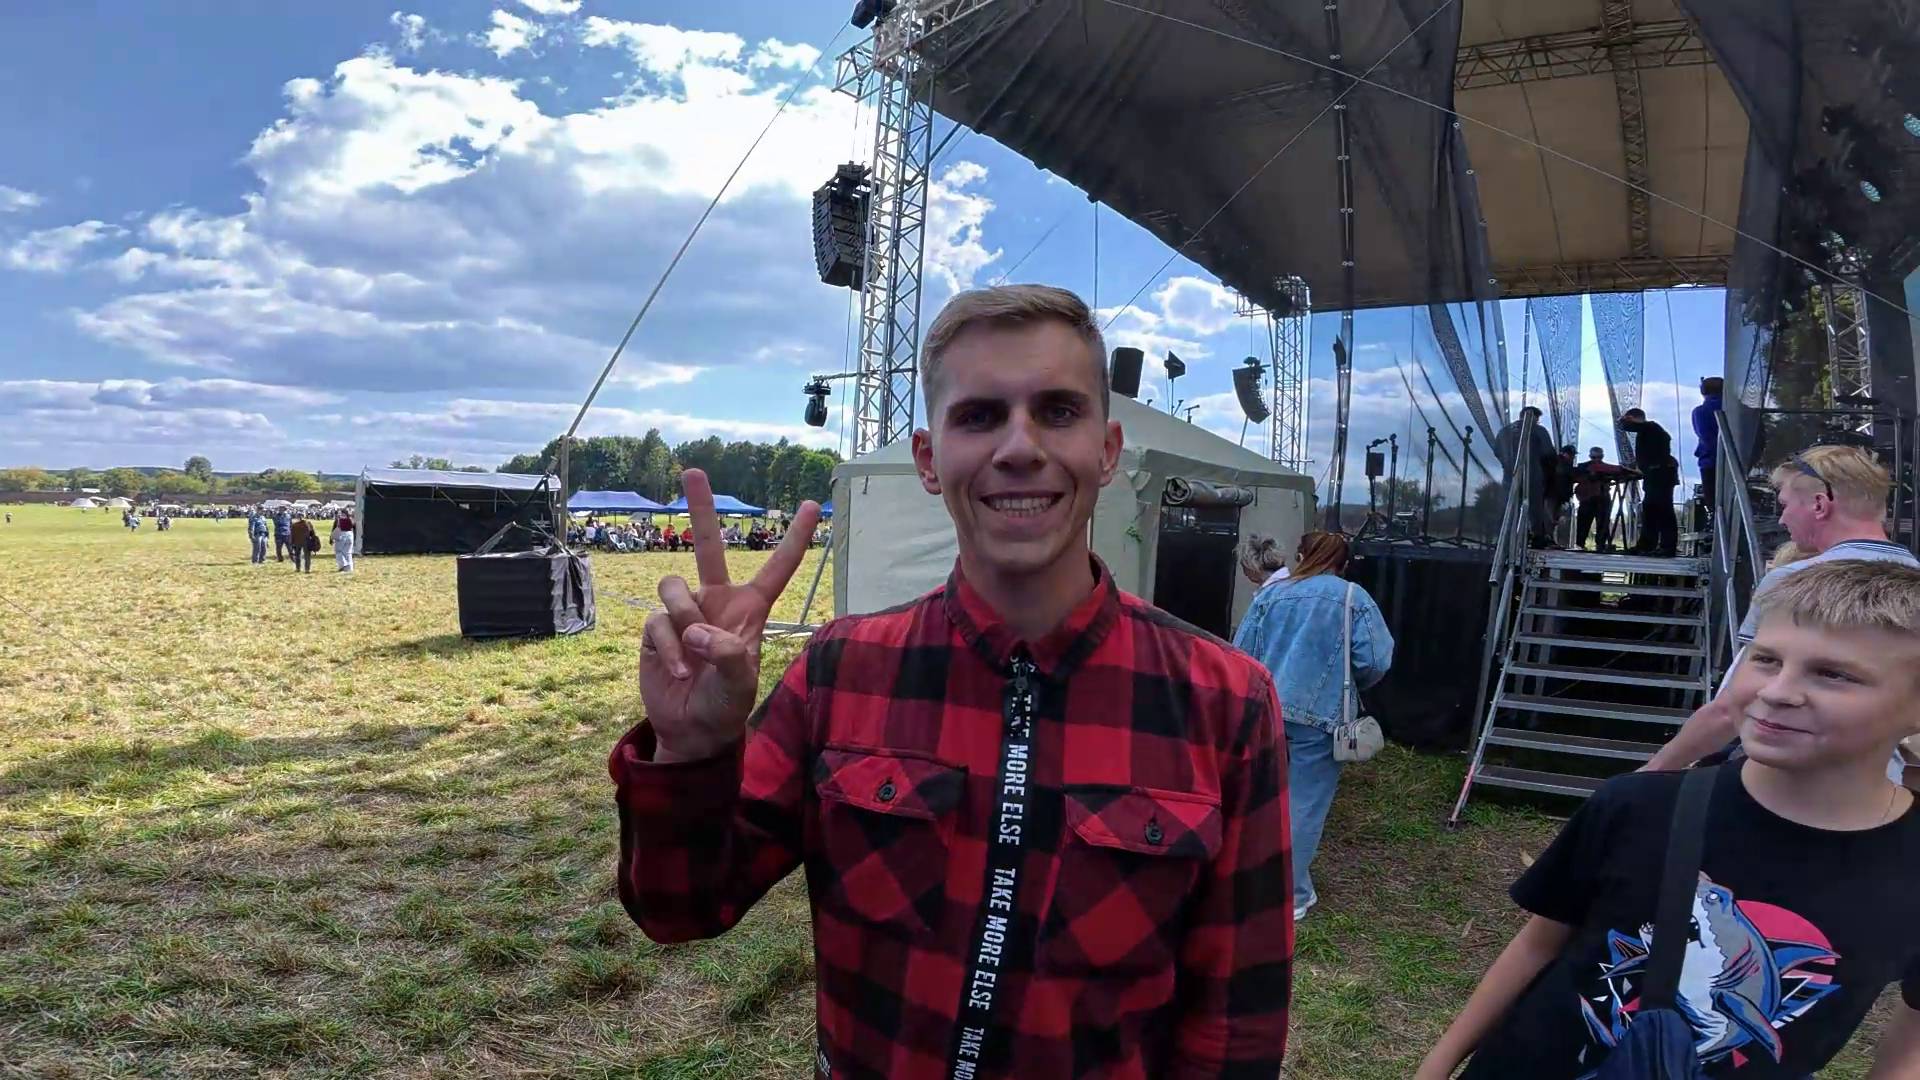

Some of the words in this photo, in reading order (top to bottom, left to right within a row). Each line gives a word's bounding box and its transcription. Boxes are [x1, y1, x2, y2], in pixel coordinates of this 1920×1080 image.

[1004, 744, 1029, 796] MORE
[998, 802, 1024, 846] ELSE
[989, 868, 1016, 912] TAKE
[978, 914, 1008, 967] MORE
[969, 970, 997, 1011] ELSE
[958, 1026, 985, 1060] TAKE
[953, 1059, 977, 1080] MO
